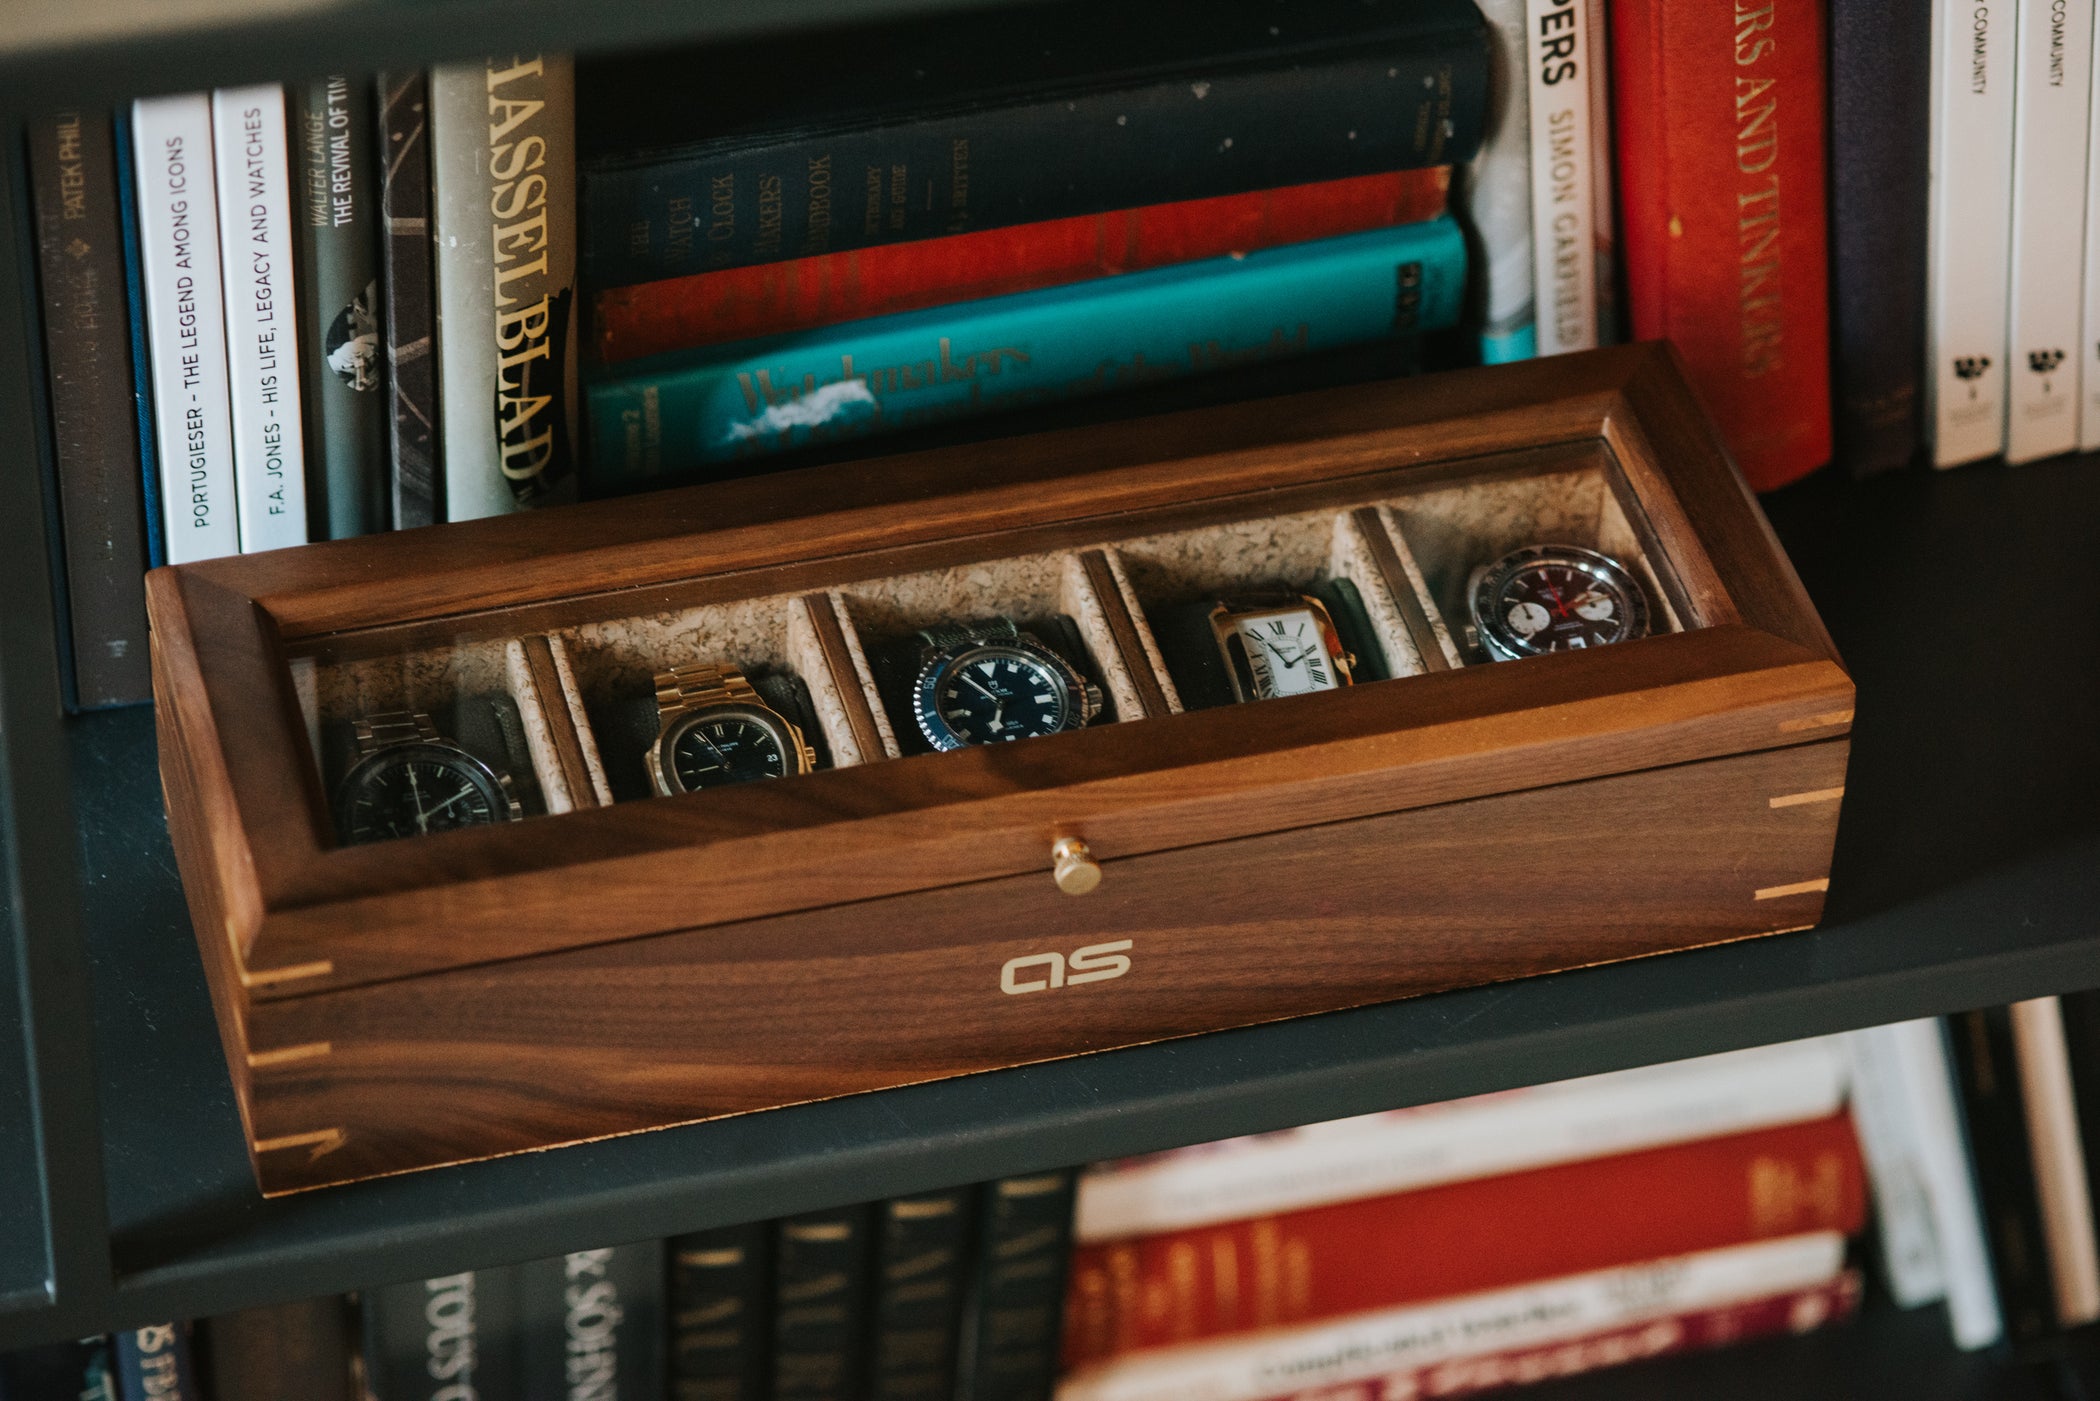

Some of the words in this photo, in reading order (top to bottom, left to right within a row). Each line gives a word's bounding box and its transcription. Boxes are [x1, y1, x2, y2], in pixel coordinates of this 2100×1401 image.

[1973, 7, 1989, 94] COMMUNITY
[2050, 0, 2066, 86] COMMUNITY
[55, 111, 82, 161] PHIL
[303, 107, 326, 163] LANGE
[328, 107, 349, 128] OF
[1735, 77, 1778, 174] AND
[165, 136, 186, 194] ICONS
[244, 108, 266, 199] WATCHES
[330, 129, 351, 193] REVIVAL
[1549, 109, 1575, 204] SIMON
[61, 165, 86, 220] PATEK
[307, 169, 329, 227] WALTER
[332, 195, 353, 227] THE
[706, 173, 735, 242] CLOCK
[170, 200, 193, 268] AMONG
[250, 204, 269, 243] AND
[176, 276, 198, 349] LEGEND
[253, 251, 274, 322] LEGACY
[182, 354, 201, 390] THE
[257, 327, 278, 370] LIFE,
[261, 375, 279, 404] HIS
[187, 408, 210, 528] PORTUGIESER
[264, 422, 283, 478] JONES
